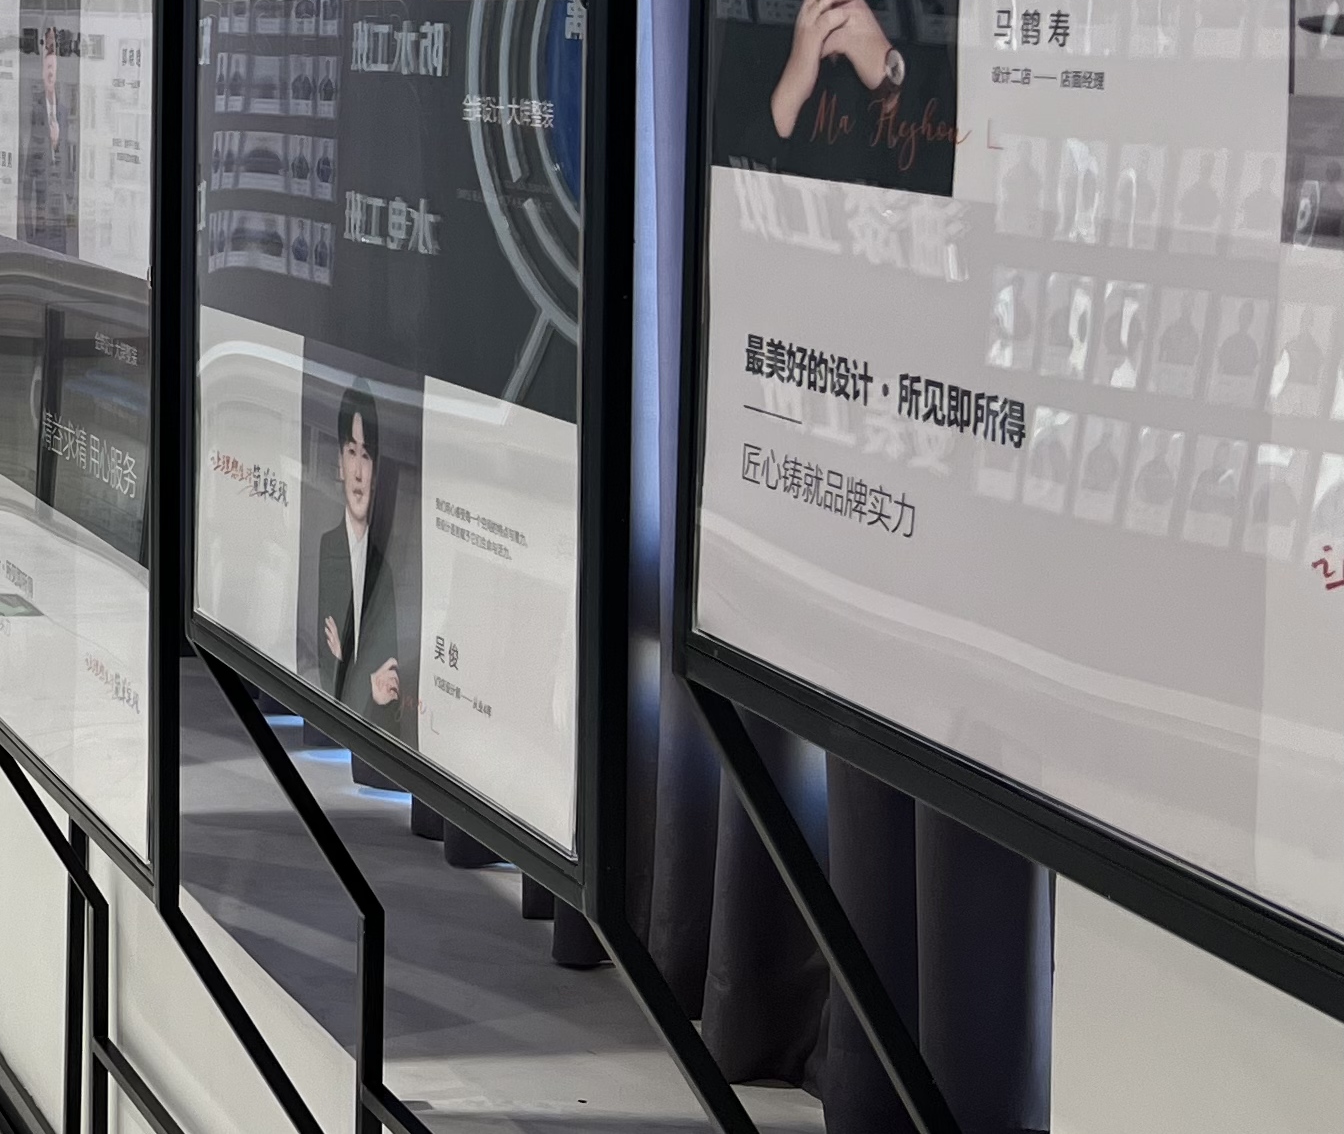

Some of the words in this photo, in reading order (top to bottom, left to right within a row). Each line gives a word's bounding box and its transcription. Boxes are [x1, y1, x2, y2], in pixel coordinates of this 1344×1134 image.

[90, 433, 137, 498] 用心服务
[741, 442, 916, 538] 匠心铸就品牌实力
[434, 635, 460, 671] 吴俊
